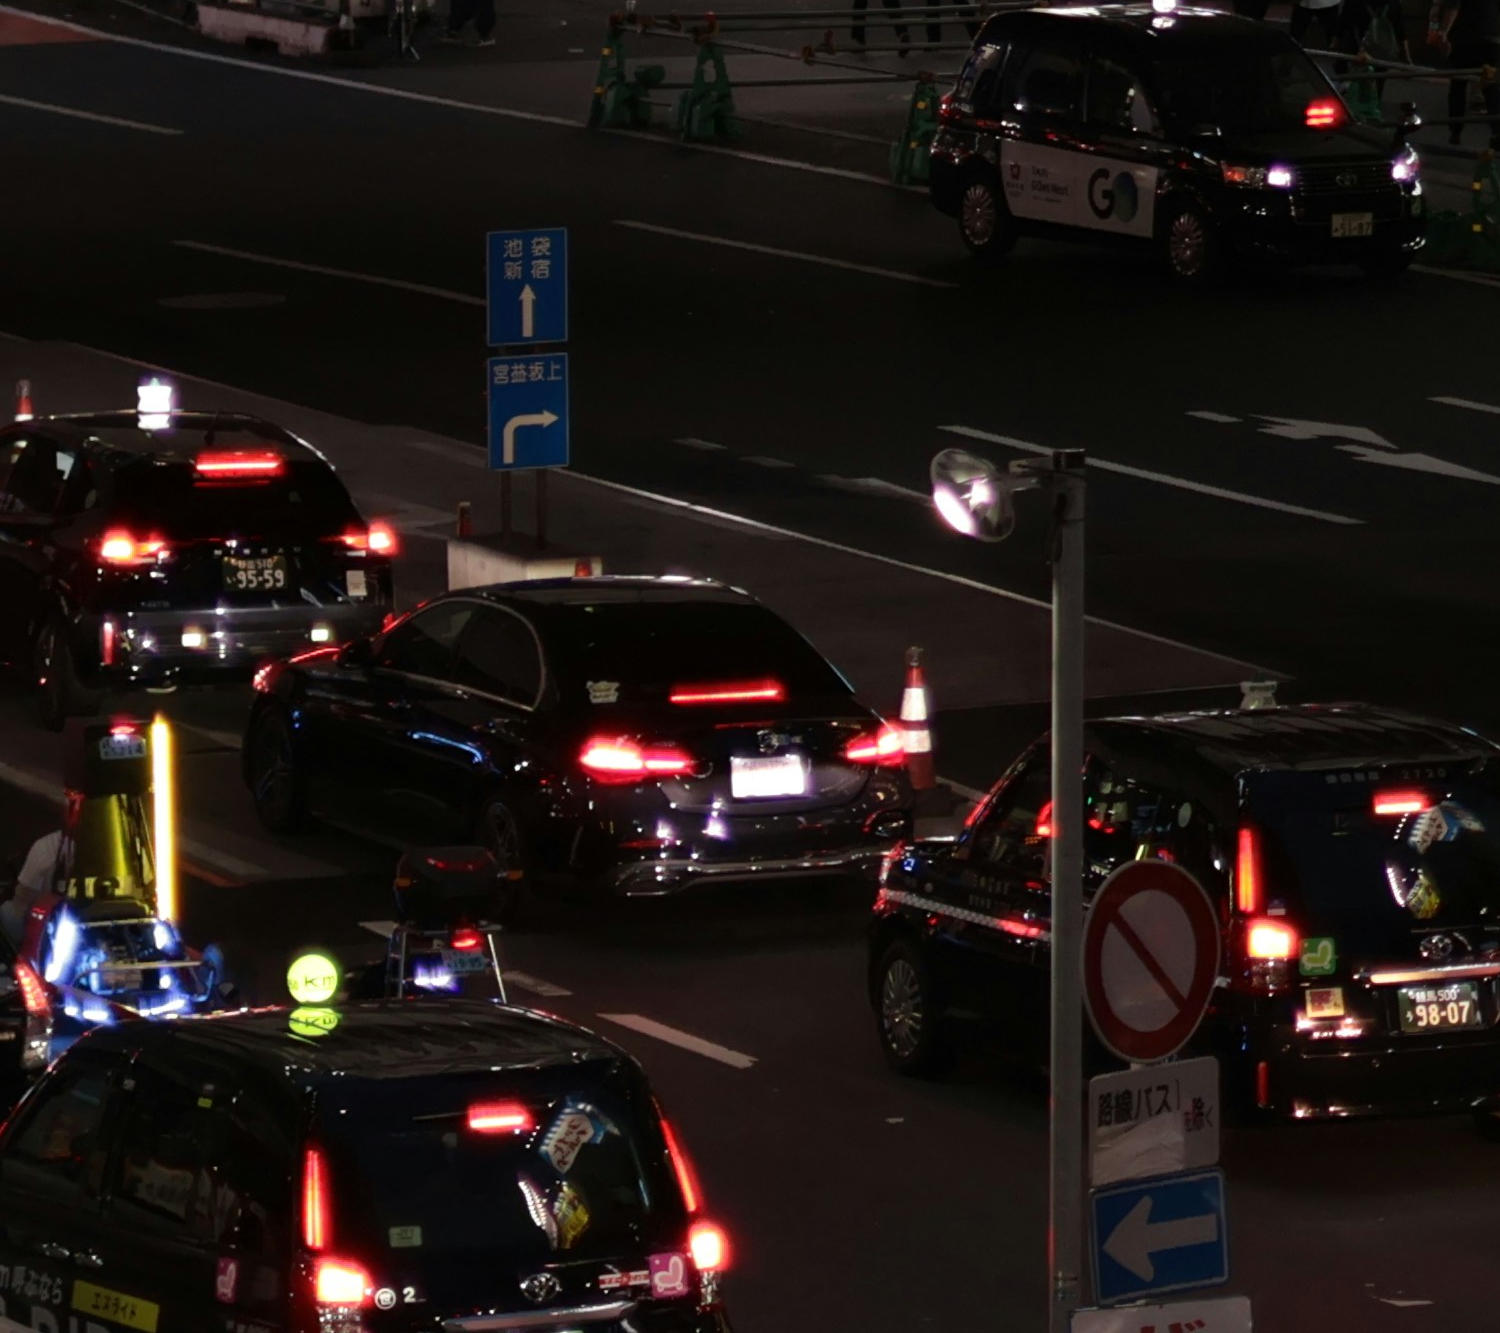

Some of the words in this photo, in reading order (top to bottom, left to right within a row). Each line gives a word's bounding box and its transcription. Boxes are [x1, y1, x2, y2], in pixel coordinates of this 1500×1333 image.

[502, 236, 552, 258] 池袋
[502, 259, 552, 281] 新宿
[493, 361, 563, 386] 宮益坂上
[236, 570, 285, 589] 95-59
[1415, 1000, 1471, 1027] 98-07
[1098, 1084, 1172, 1127] 路線バス
